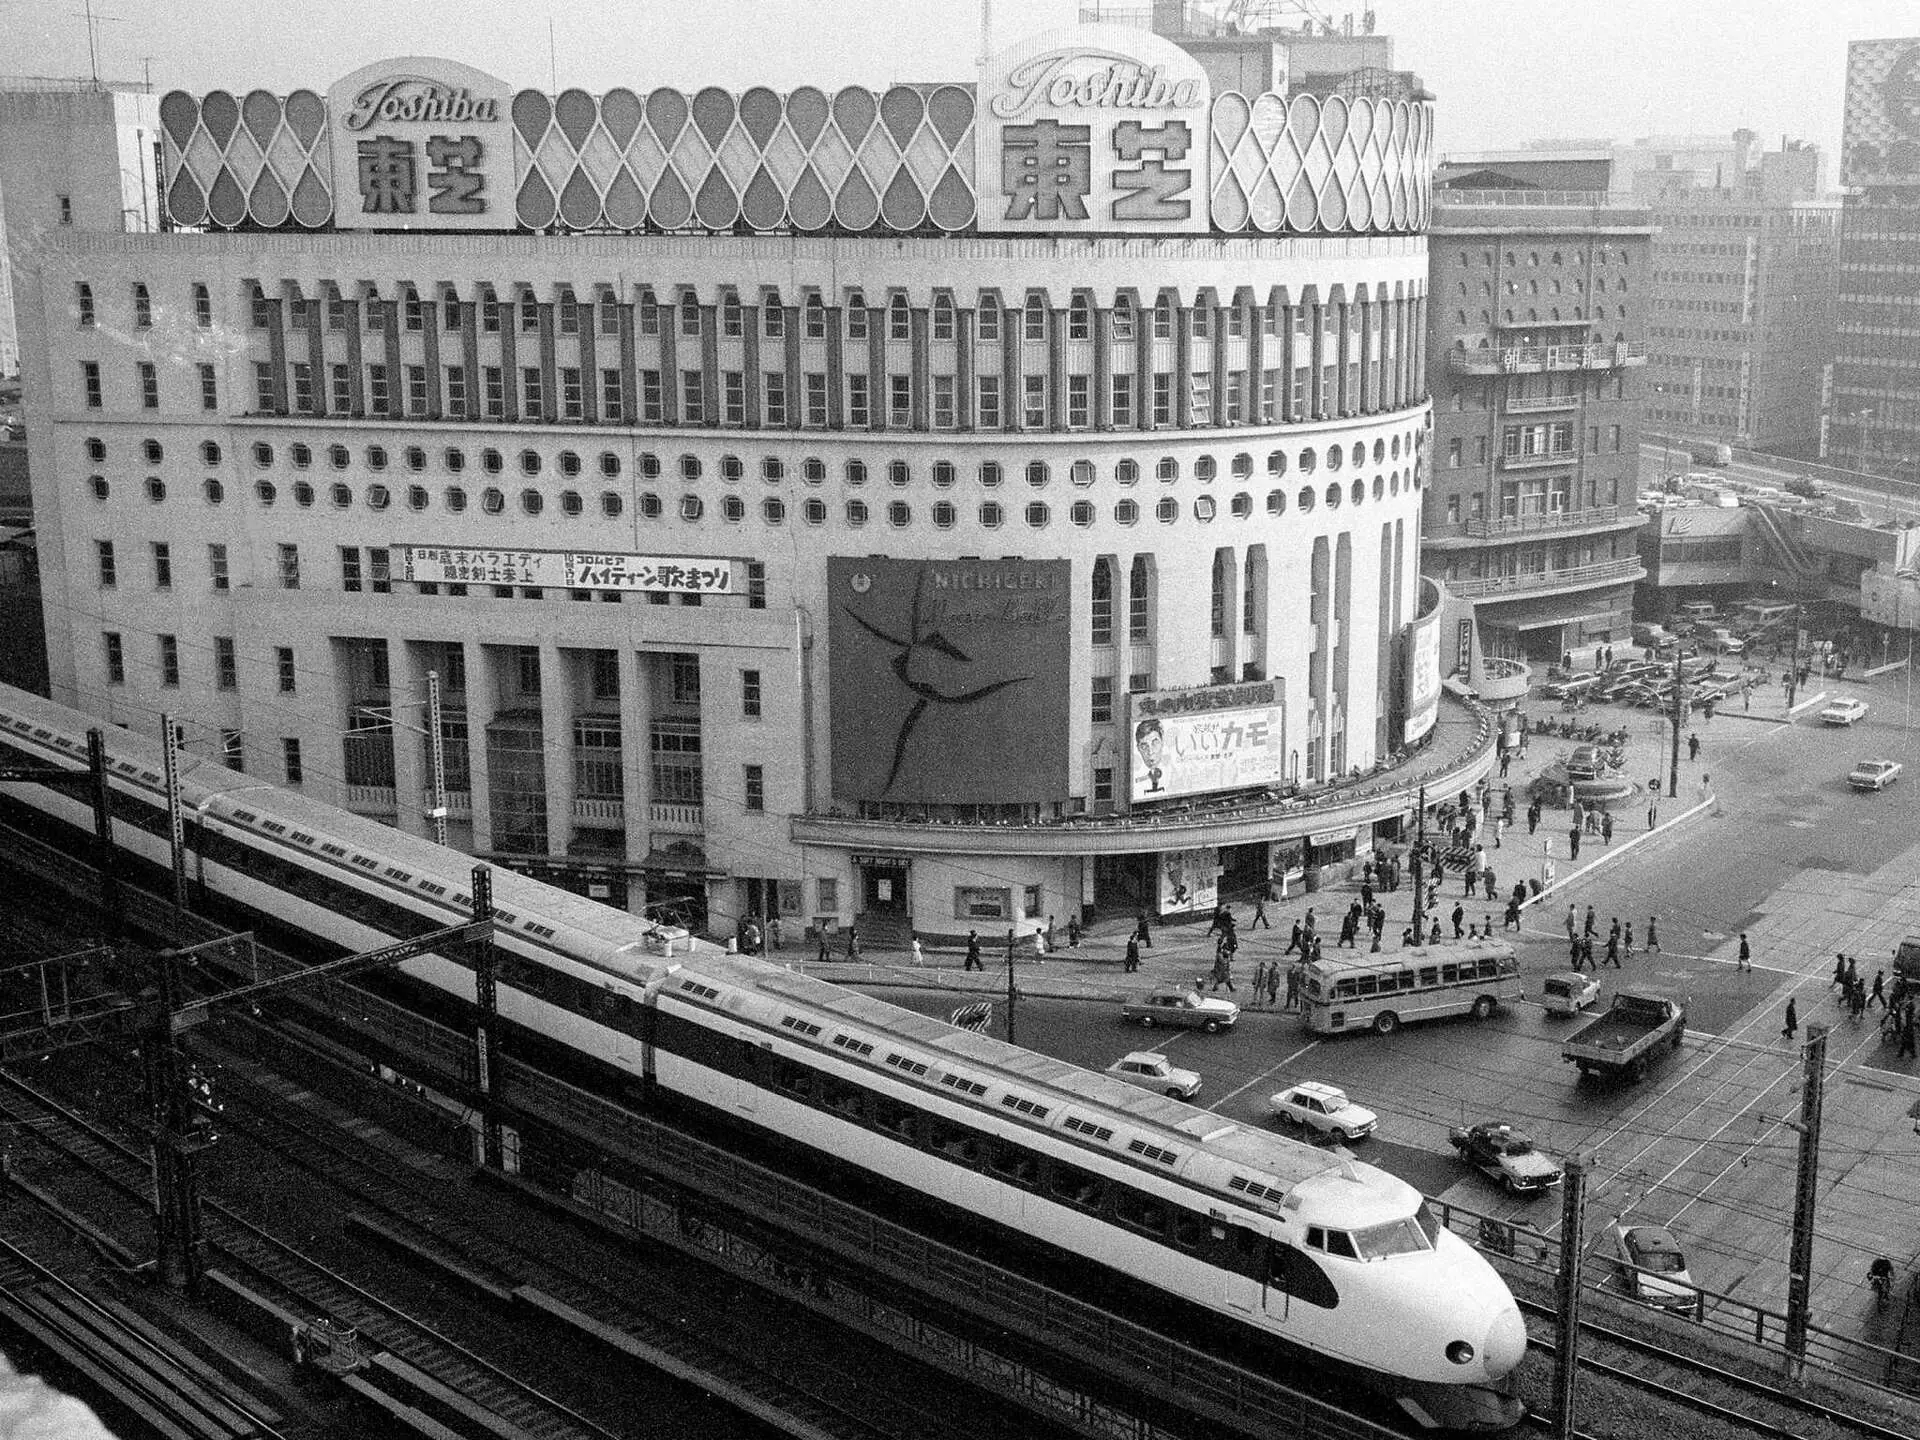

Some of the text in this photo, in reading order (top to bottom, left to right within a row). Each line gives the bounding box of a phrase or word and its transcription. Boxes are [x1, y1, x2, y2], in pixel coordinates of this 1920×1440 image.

[341, 74, 500, 131] Toshiba
[991, 47, 1205, 119] Toshiba
[356, 135, 486, 214] 東芝
[1002, 119, 1192, 221] 東芝
[576, 556, 626, 566] コロムビア
[579, 565, 730, 590] ハイティーン歌まつり
[1174, 720, 1269, 757] いいカモ
